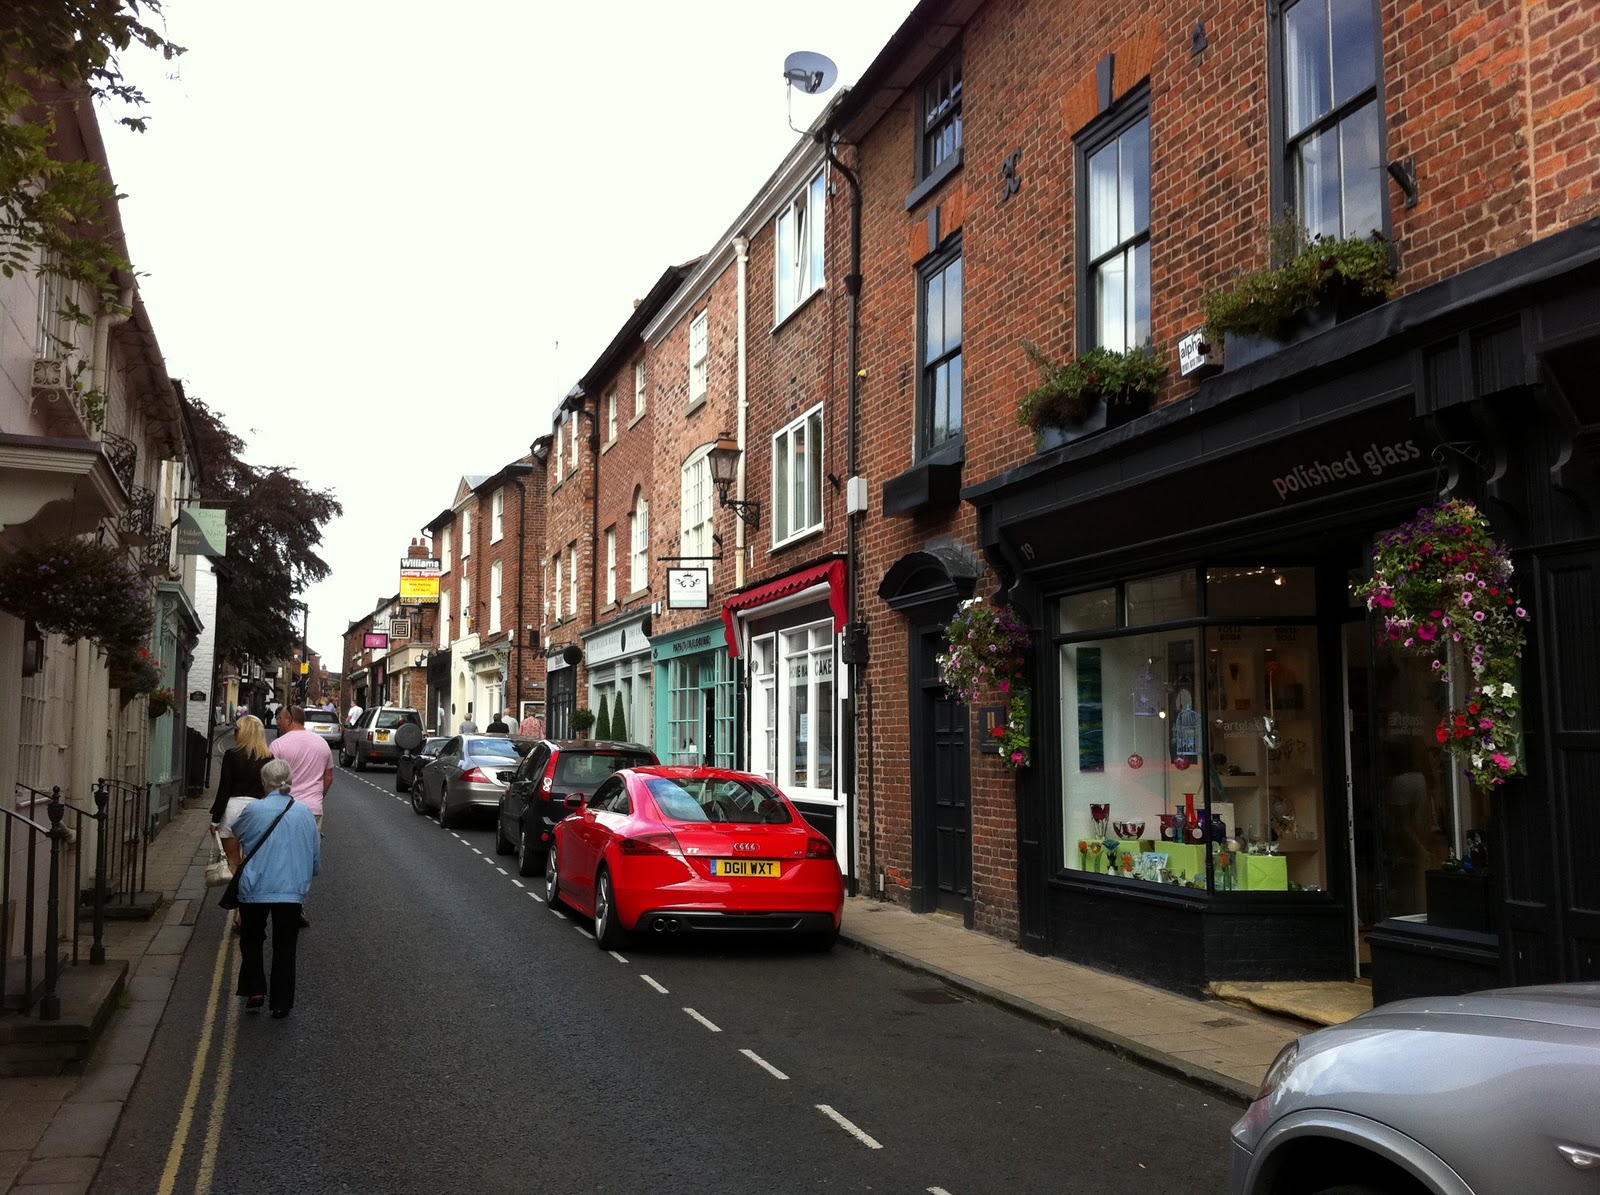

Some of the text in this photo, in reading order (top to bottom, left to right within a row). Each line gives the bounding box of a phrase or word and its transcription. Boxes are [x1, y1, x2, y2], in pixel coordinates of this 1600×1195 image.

[1272, 439, 1421, 500] polished glass
[1020, 542, 1035, 560] 19
[402, 559, 439, 568] Williams
[723, 861, 774, 875] DG11 WXT
